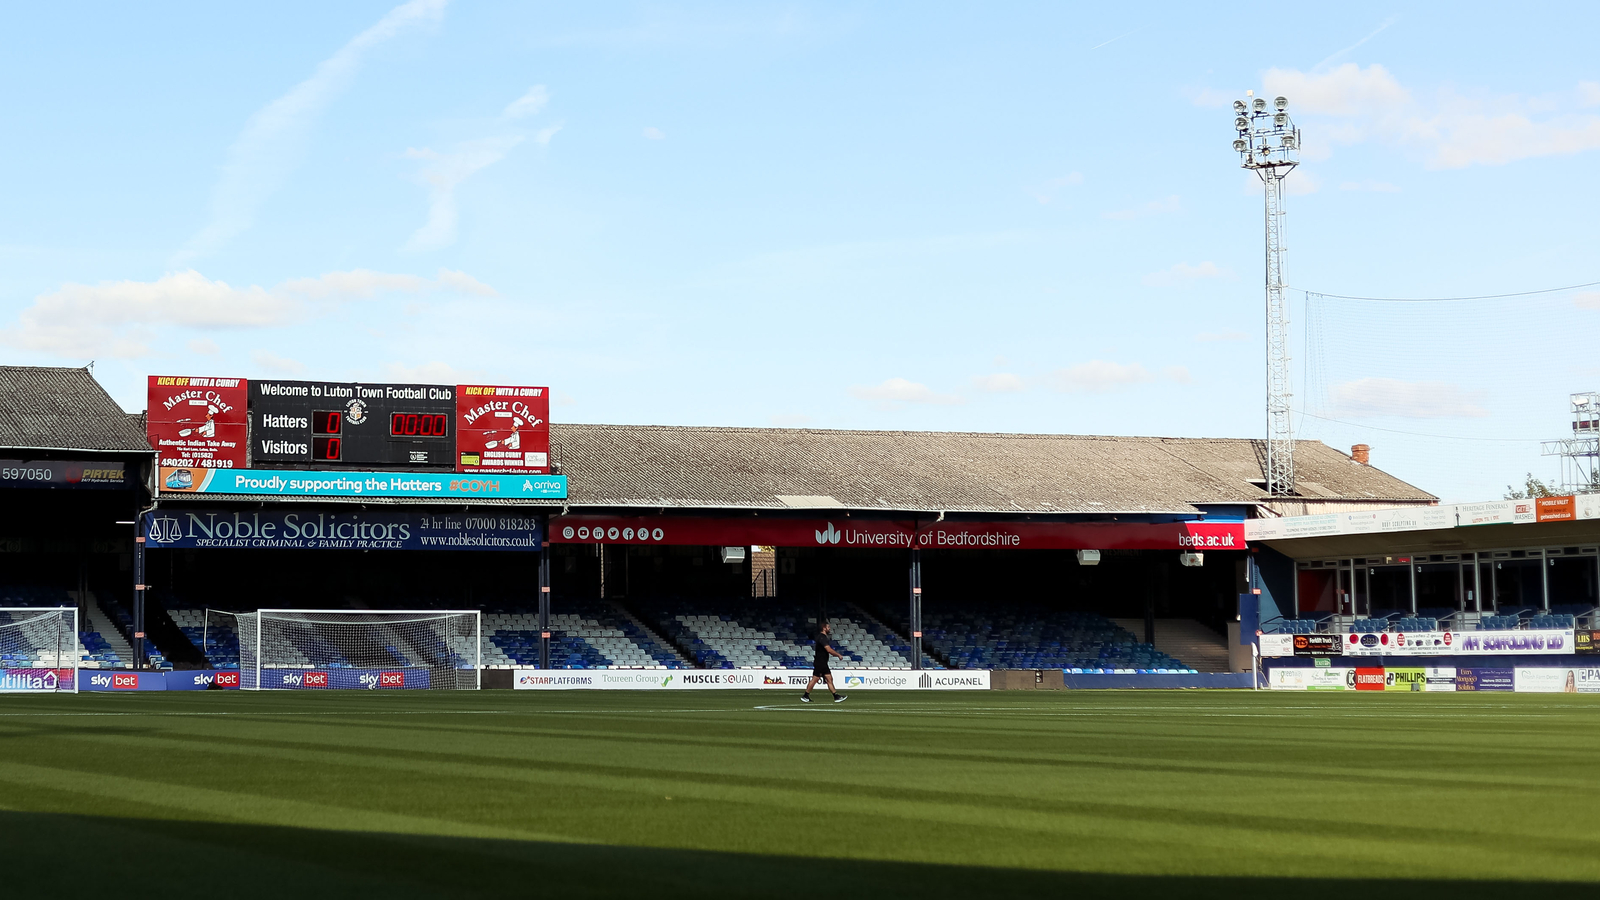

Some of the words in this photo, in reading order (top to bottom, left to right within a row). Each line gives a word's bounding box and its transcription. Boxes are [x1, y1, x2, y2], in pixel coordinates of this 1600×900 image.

[157, 377, 176, 386] KICK
[176, 378, 189, 386] OFF
[189, 378, 209, 387] WITH
[209, 379, 215, 387] A
[215, 379, 240, 388] CURRY
[261, 384, 309, 397] Welcome
[311, 385, 322, 397] to
[324, 385, 353, 398] Luton
[355, 386, 384, 398] Town
[387, 387, 427, 400] Football
[429, 388, 452, 400] Club
[465, 387, 483, 395] KICK
[483, 387, 496, 396] OFF
[495, 388, 514, 396] WITH
[514, 388, 520, 396] A
[520, 388, 543, 397] CURRY
[163, 390, 203, 411] Master
[206, 391, 233, 413] Chef
[464, 400, 509, 425] Master
[512, 401, 543, 428] Chef
[263, 414, 308, 428] Hatters
[326, 412, 341, 434] 0
[392, 414, 446, 436] 00:00
[262, 440, 308, 455] Visitors
[326, 438, 341, 460] 0
[201, 459, 234, 468] 481919
[2, 468, 52, 481] 597050
[82, 469, 126, 479] PIRTEK
[235, 476, 287, 494] Proudly
[290, 478, 363, 495] supporting
[365, 478, 388, 491] the
[391, 479, 442, 491] Hatters
[449, 480, 500, 492] #COYH
[534, 481, 561, 489] arriva
[1462, 505, 1485, 513] HERITAGE
[185, 512, 276, 539] Noble
[283, 514, 411, 540] Solicitors
[420, 518, 430, 530] 24
[432, 518, 443, 530] hr
[445, 518, 462, 530] line
[465, 518, 496, 531] 07000
[499, 518, 536, 531] 818283
[196, 539, 251, 547] SPECIALIST
[252, 540, 305, 548] CRIMINAL
[308, 540, 317, 548] &
[318, 540, 354, 548] FAMILY
[356, 540, 403, 549] PRACTICE
[420, 533, 536, 547] www.noblesolicitors.co.uk
[846, 530, 914, 548] University
[919, 531, 934, 545] of
[938, 531, 1020, 546] Bedfordshire
[1179, 533, 1235, 547] beds.ac.uk
[1483, 634, 1545, 651] SCAFFOLDING
[1547, 634, 1565, 650] LTD
[0, 674, 42, 689] utilita
[91, 674, 112, 687] sky
[115, 674, 136, 686] bet
[194, 674, 214, 687] sky
[217, 674, 237, 684] bet
[283, 673, 303, 686] sky
[307, 674, 326, 684] bet
[359, 673, 379, 686] sky
[383, 674, 402, 684] bet
[530, 676, 593, 685] STARPLATFORMS
[602, 675, 634, 683] Toureen
[635, 675, 659, 685] Group
[683, 675, 720, 684] MUSCLE
[723, 675, 754, 684] SQUAD
[865, 677, 907, 686] ryebridge
[935, 678, 983, 686] ACUPANEL
[1358, 674, 1384, 684] FLATBREADS
[1395, 673, 1426, 683] PHILLIPS
